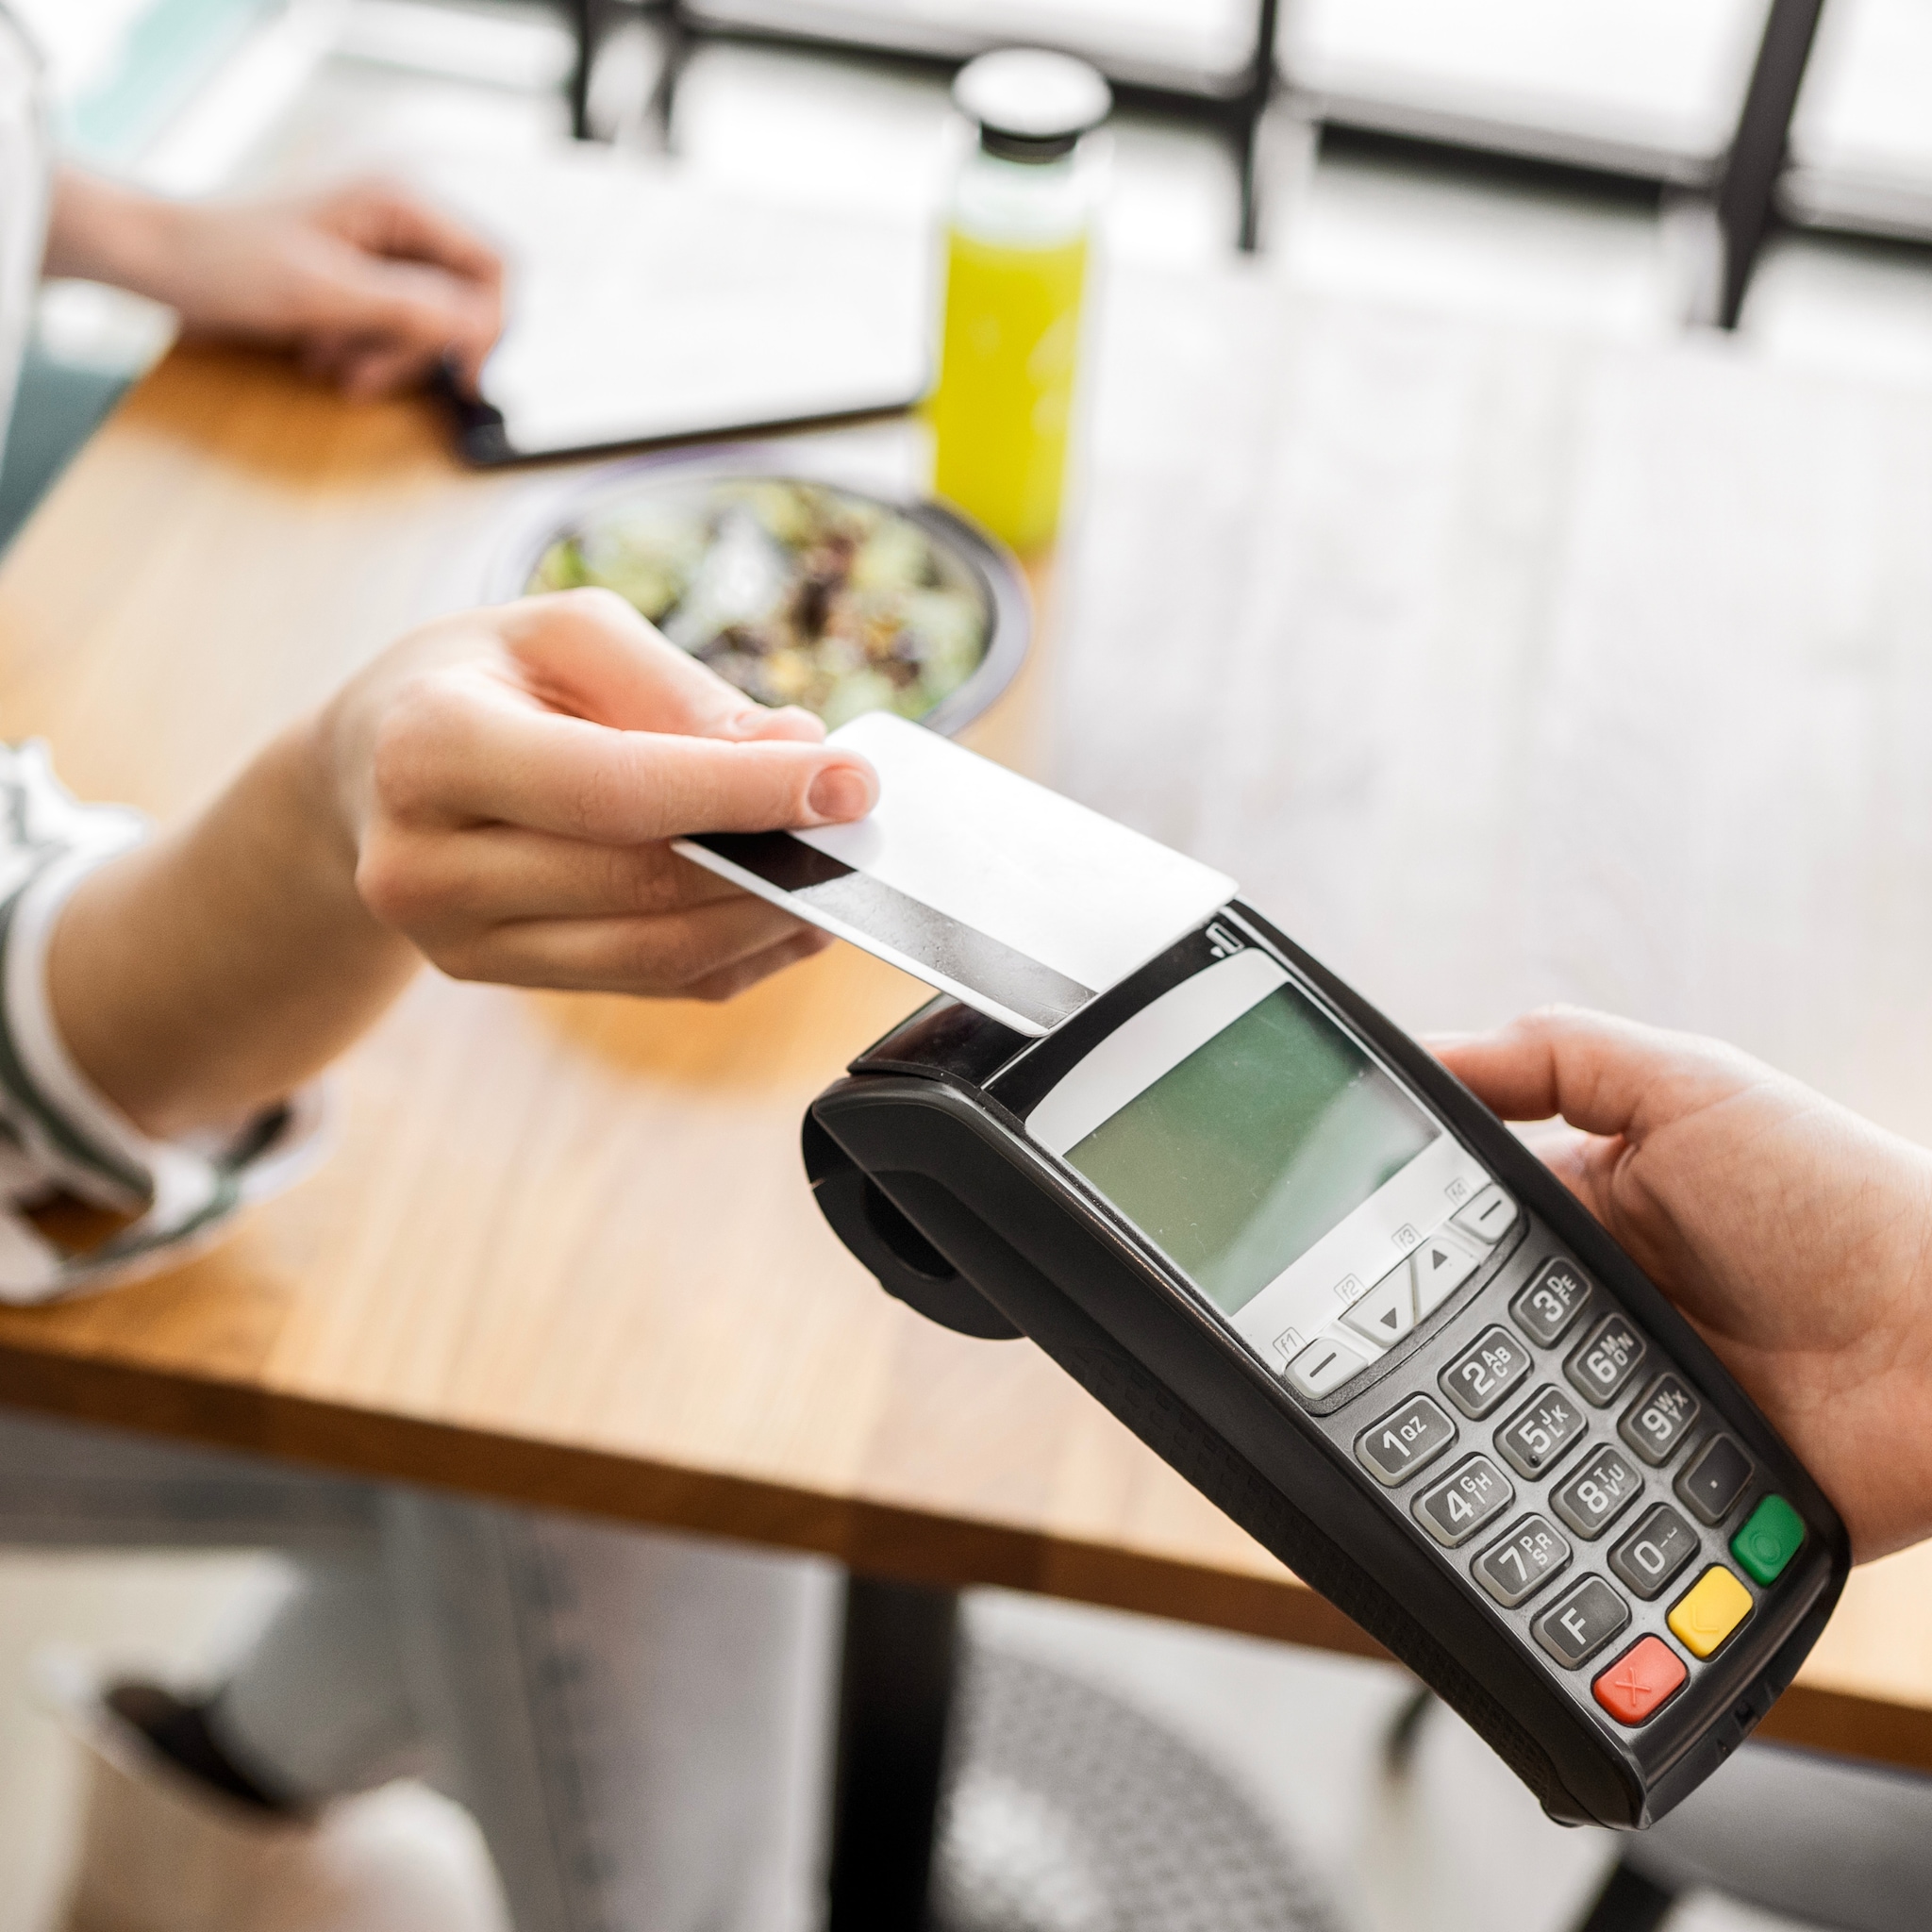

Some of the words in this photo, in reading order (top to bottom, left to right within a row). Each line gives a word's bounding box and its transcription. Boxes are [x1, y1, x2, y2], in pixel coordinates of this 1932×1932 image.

[1398, 1227, 1417, 1247] f3
[1341, 1279, 1359, 1301] f2
[1279, 1333, 1298, 1355] f1
[1560, 1607, 1587, 1645] F
